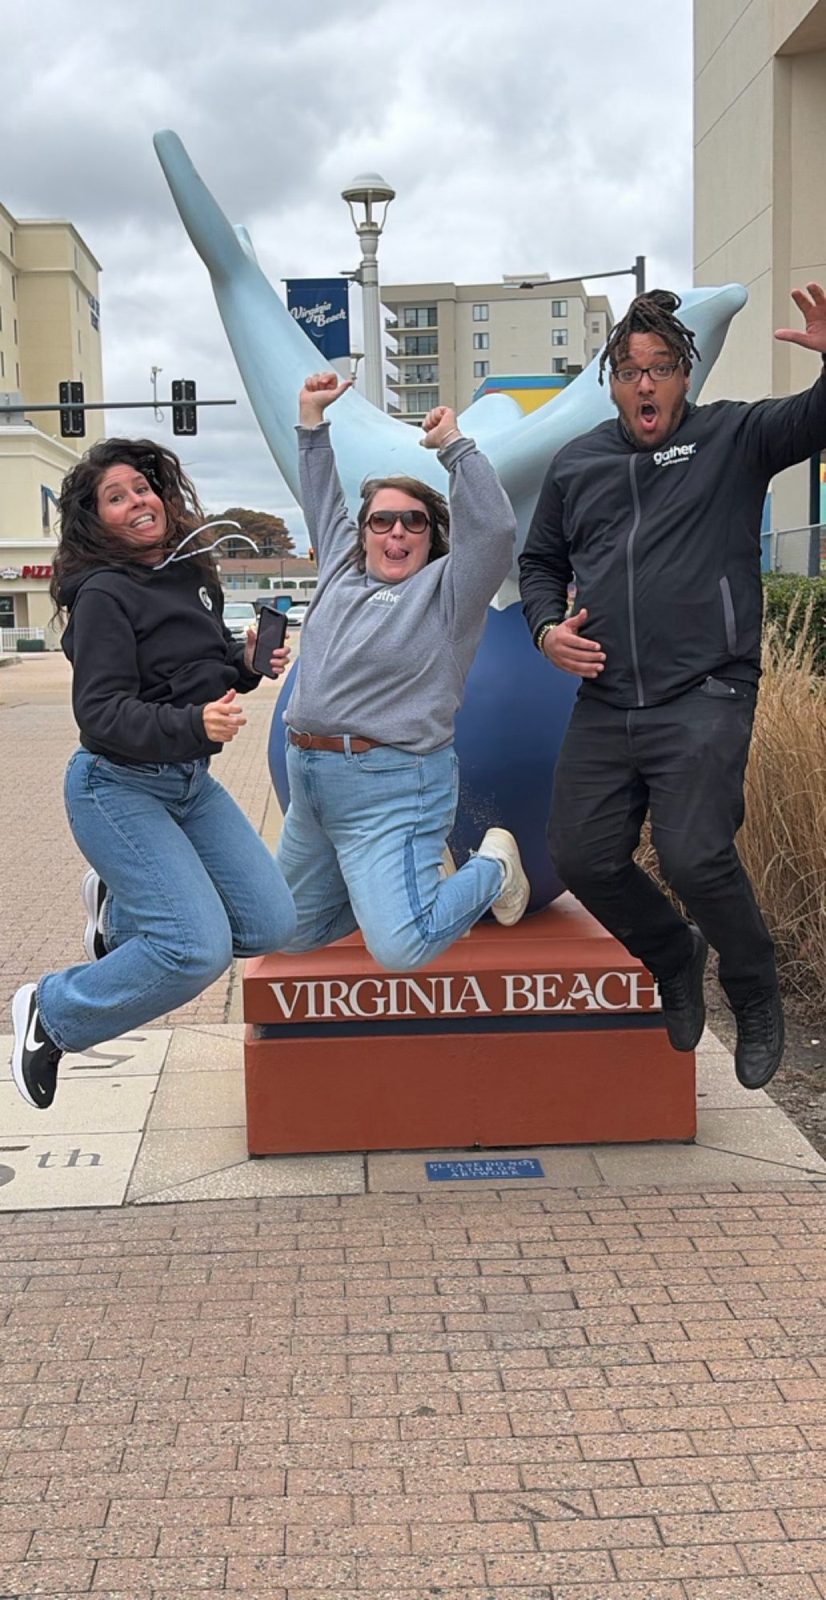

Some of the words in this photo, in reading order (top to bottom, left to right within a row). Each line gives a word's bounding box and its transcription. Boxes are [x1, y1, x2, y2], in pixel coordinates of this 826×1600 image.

[290, 301, 331, 324] Virginia
[313, 308, 347, 327] Beach
[268, 976, 492, 1019] VIRGINIA
[501, 972, 662, 1012] BEACH
[429, 1162, 481, 1170] PLEASE
